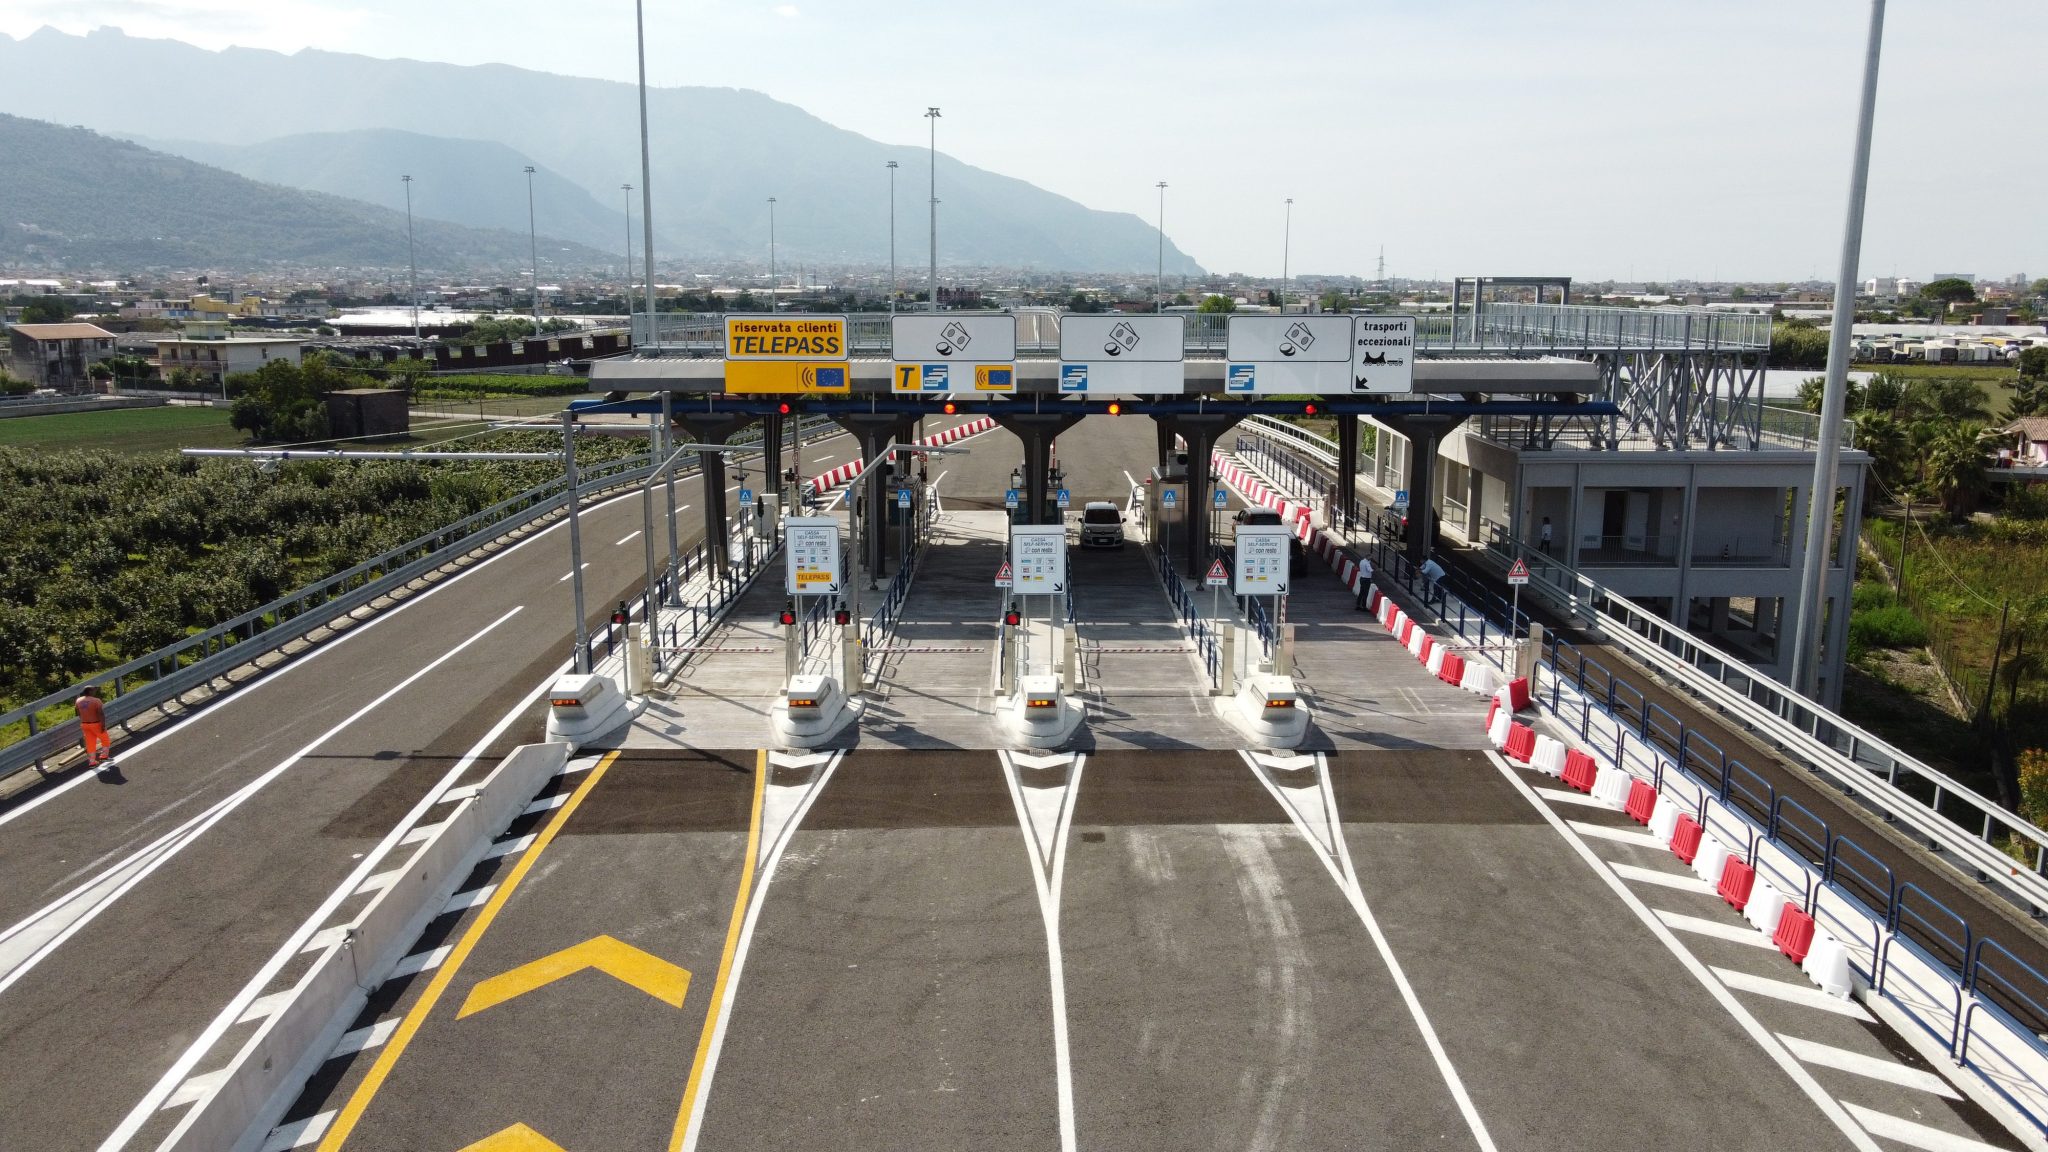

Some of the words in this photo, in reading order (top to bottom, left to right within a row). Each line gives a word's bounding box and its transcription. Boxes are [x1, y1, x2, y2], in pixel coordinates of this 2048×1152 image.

[734, 322, 791, 333] riservata
[797, 322, 837, 333] clienti
[1364, 321, 1407, 333] trasporti
[733, 336, 839, 354] TELEPASS
[1358, 336, 1411, 346] eccezionali
[900, 367, 915, 388] T
